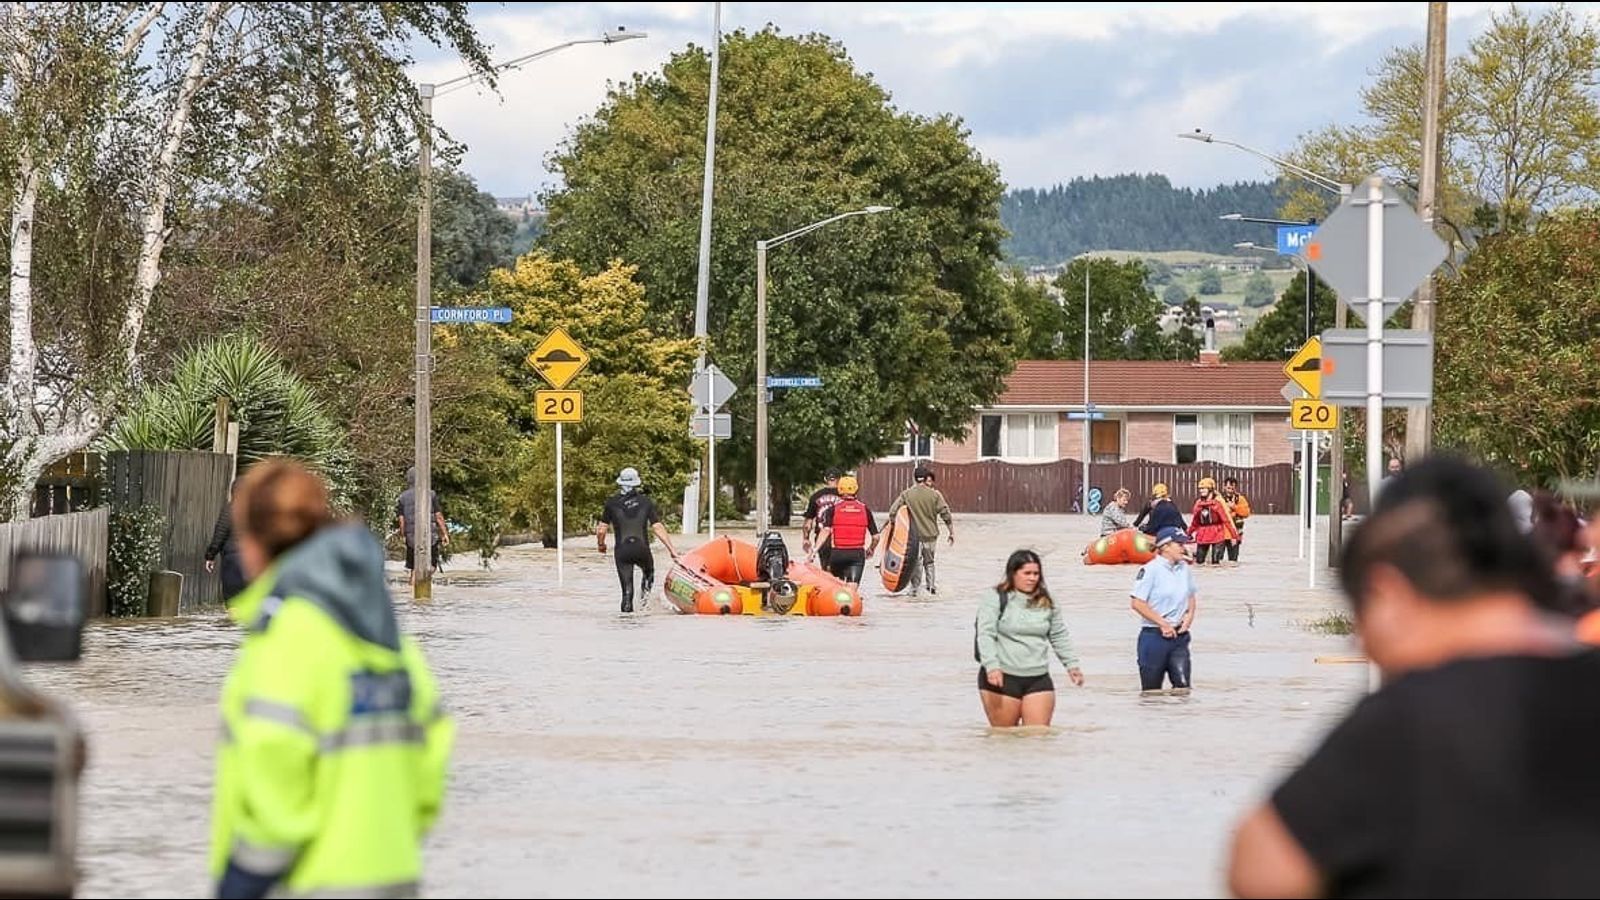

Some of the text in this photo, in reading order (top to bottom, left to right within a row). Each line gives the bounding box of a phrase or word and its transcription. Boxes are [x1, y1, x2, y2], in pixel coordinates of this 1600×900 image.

[438, 309, 504, 320] CORNFORD PL
[544, 398, 574, 414] 20
[1300, 405, 1330, 422] 20
